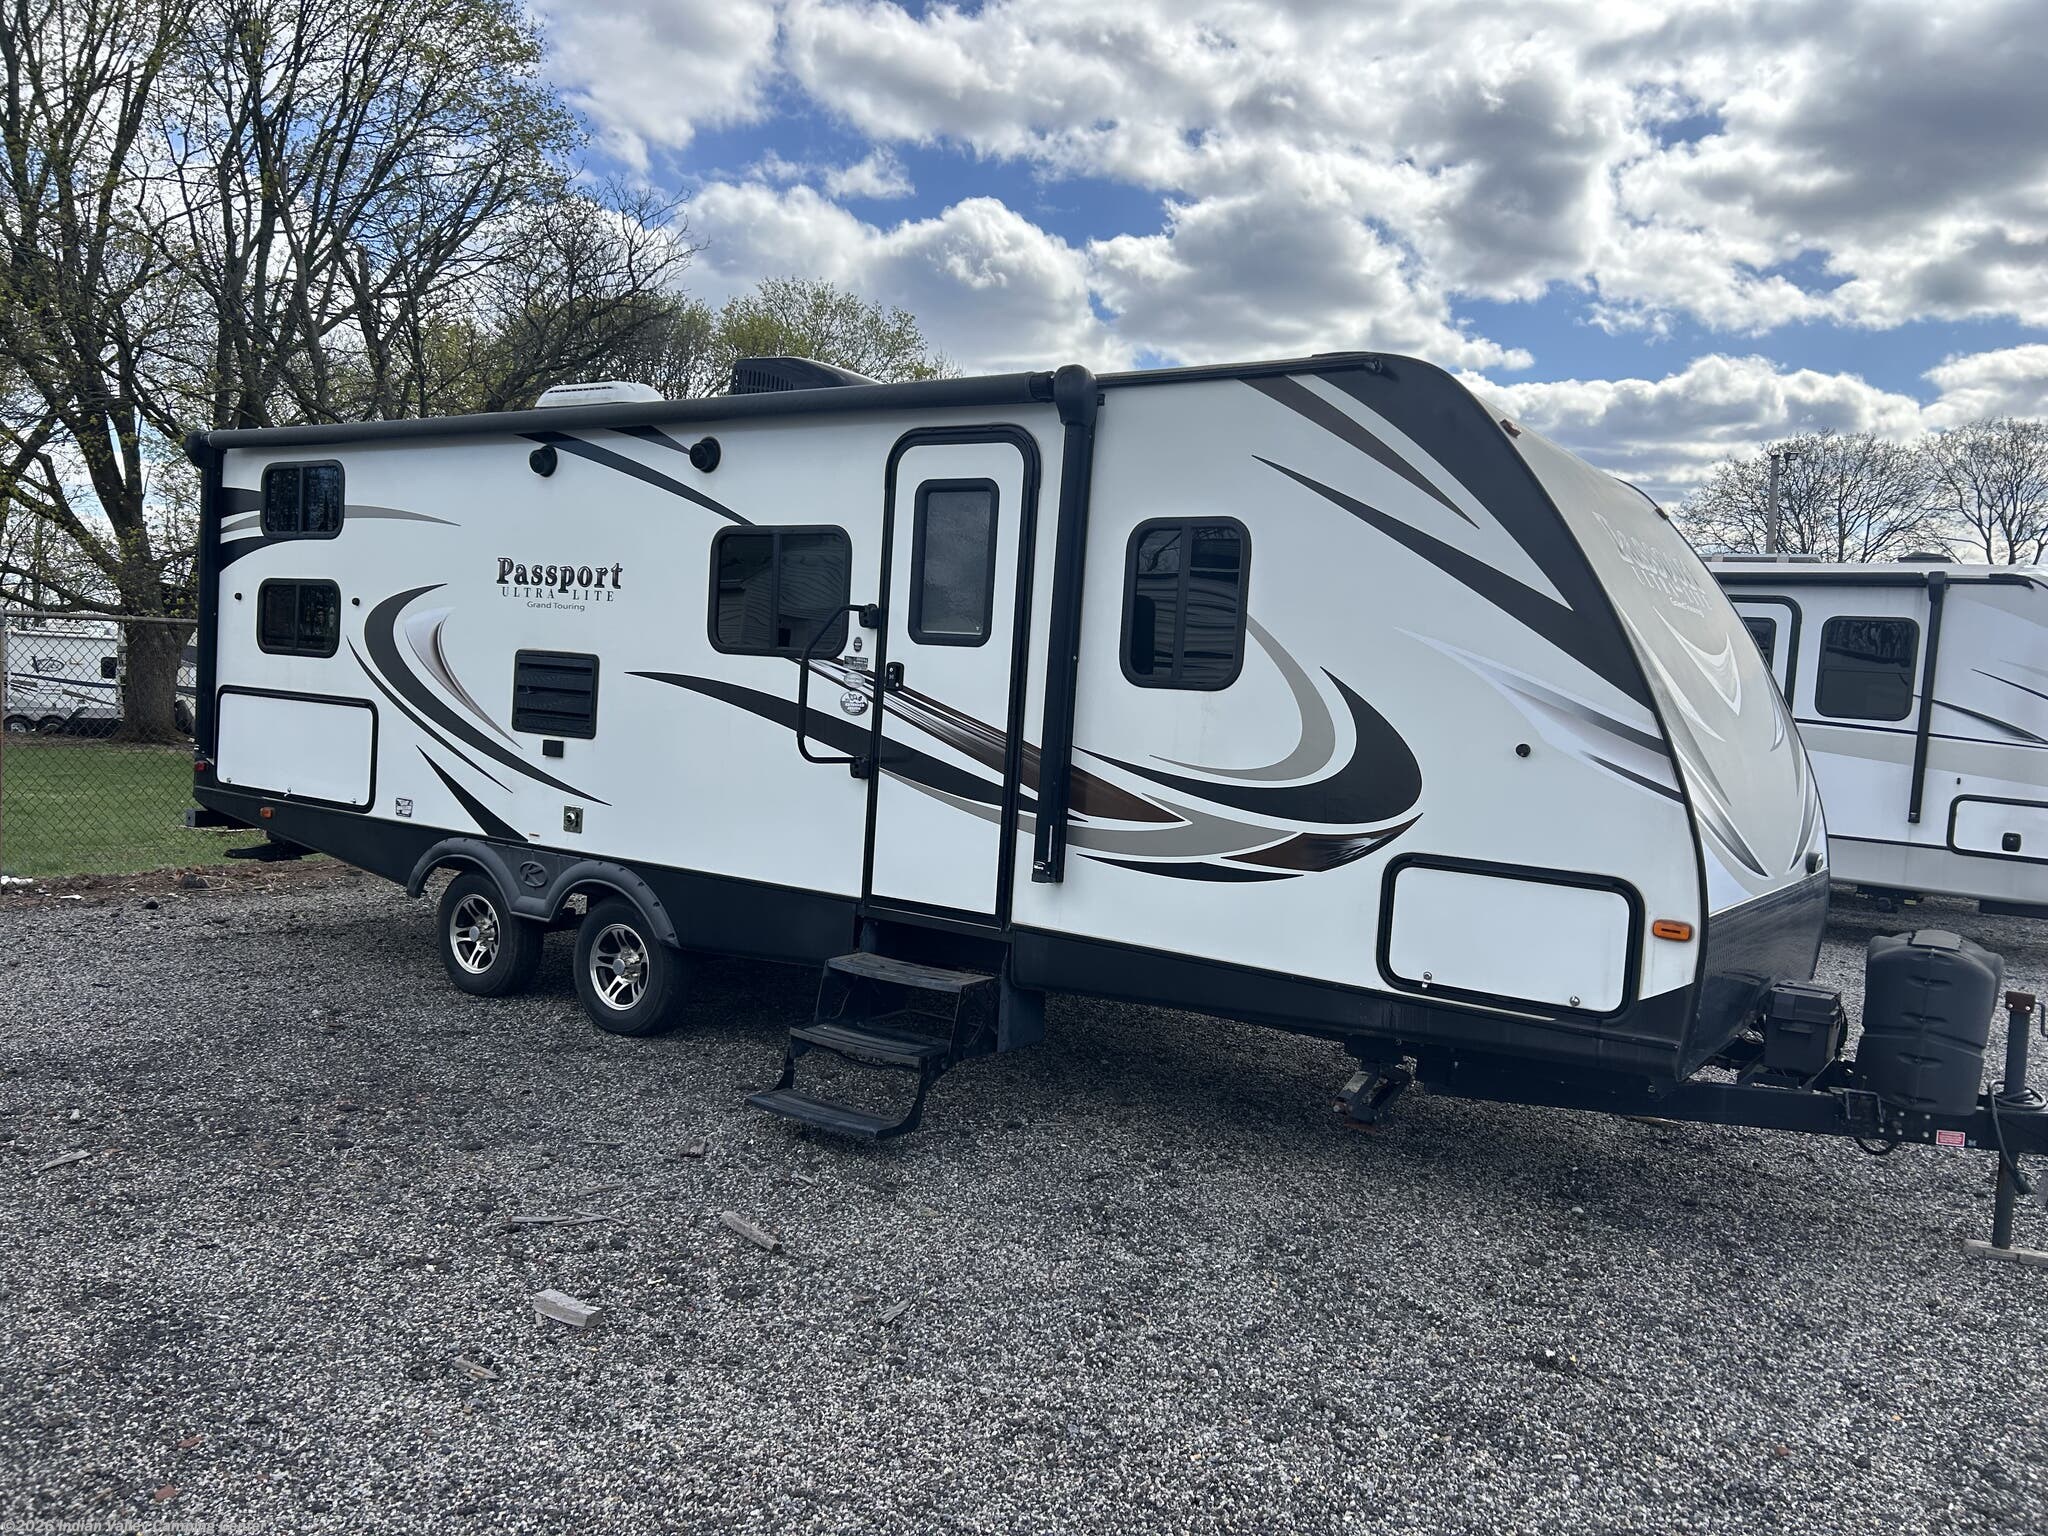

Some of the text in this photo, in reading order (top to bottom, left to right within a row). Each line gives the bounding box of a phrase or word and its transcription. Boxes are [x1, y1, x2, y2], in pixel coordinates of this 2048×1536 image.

[496, 557, 623, 593] Passport
[502, 587, 614, 602] ULTRA LITE
[527, 601, 585, 612] Grand Touring
